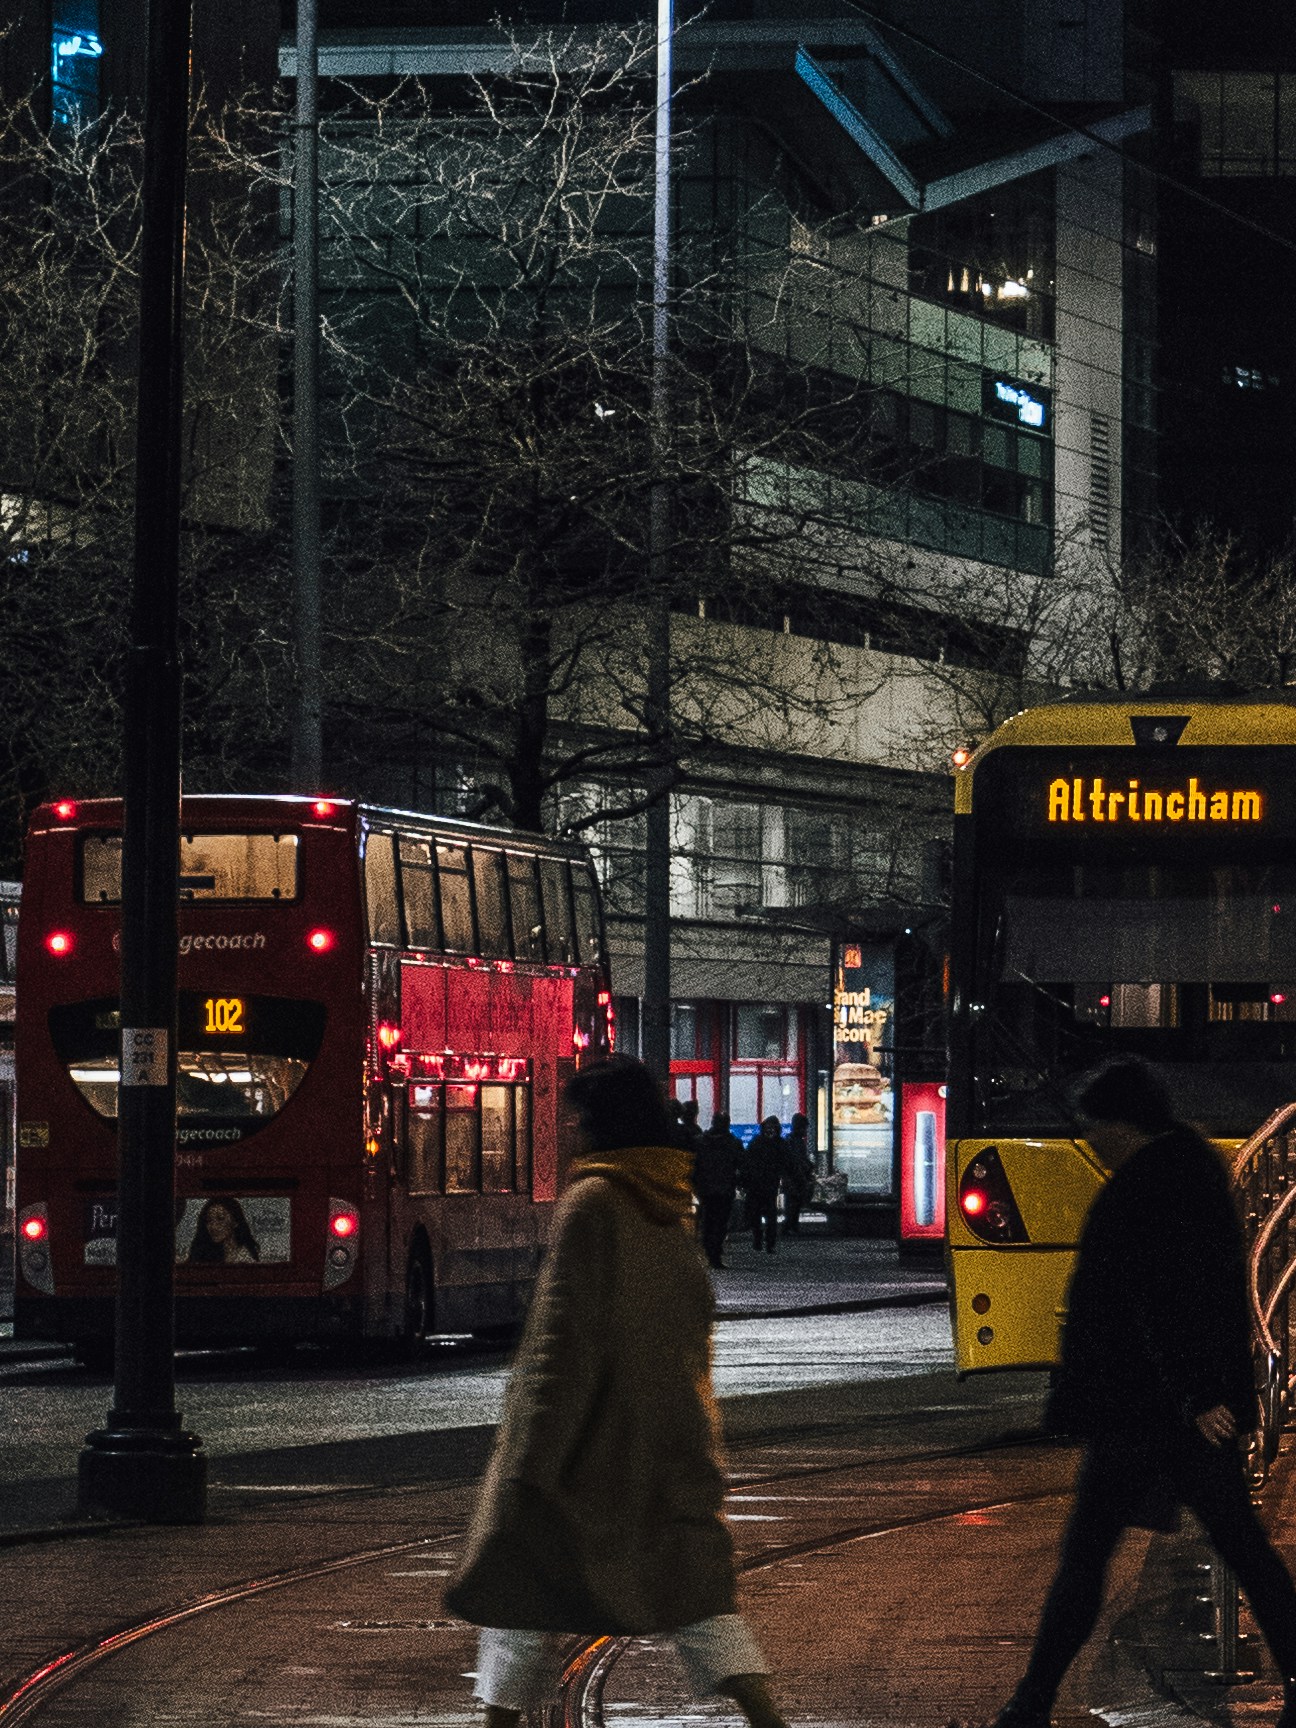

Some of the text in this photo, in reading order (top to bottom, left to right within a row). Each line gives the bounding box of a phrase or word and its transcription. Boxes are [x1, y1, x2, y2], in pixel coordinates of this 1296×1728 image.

[1049, 778, 1262, 821] Altrincham
[179, 931, 266, 955] gecoach
[205, 998, 243, 1032] 102
[133, 1033, 155, 1046] CC
[137, 1070, 149, 1082] A
[176, 1127, 241, 1145] gecoach
